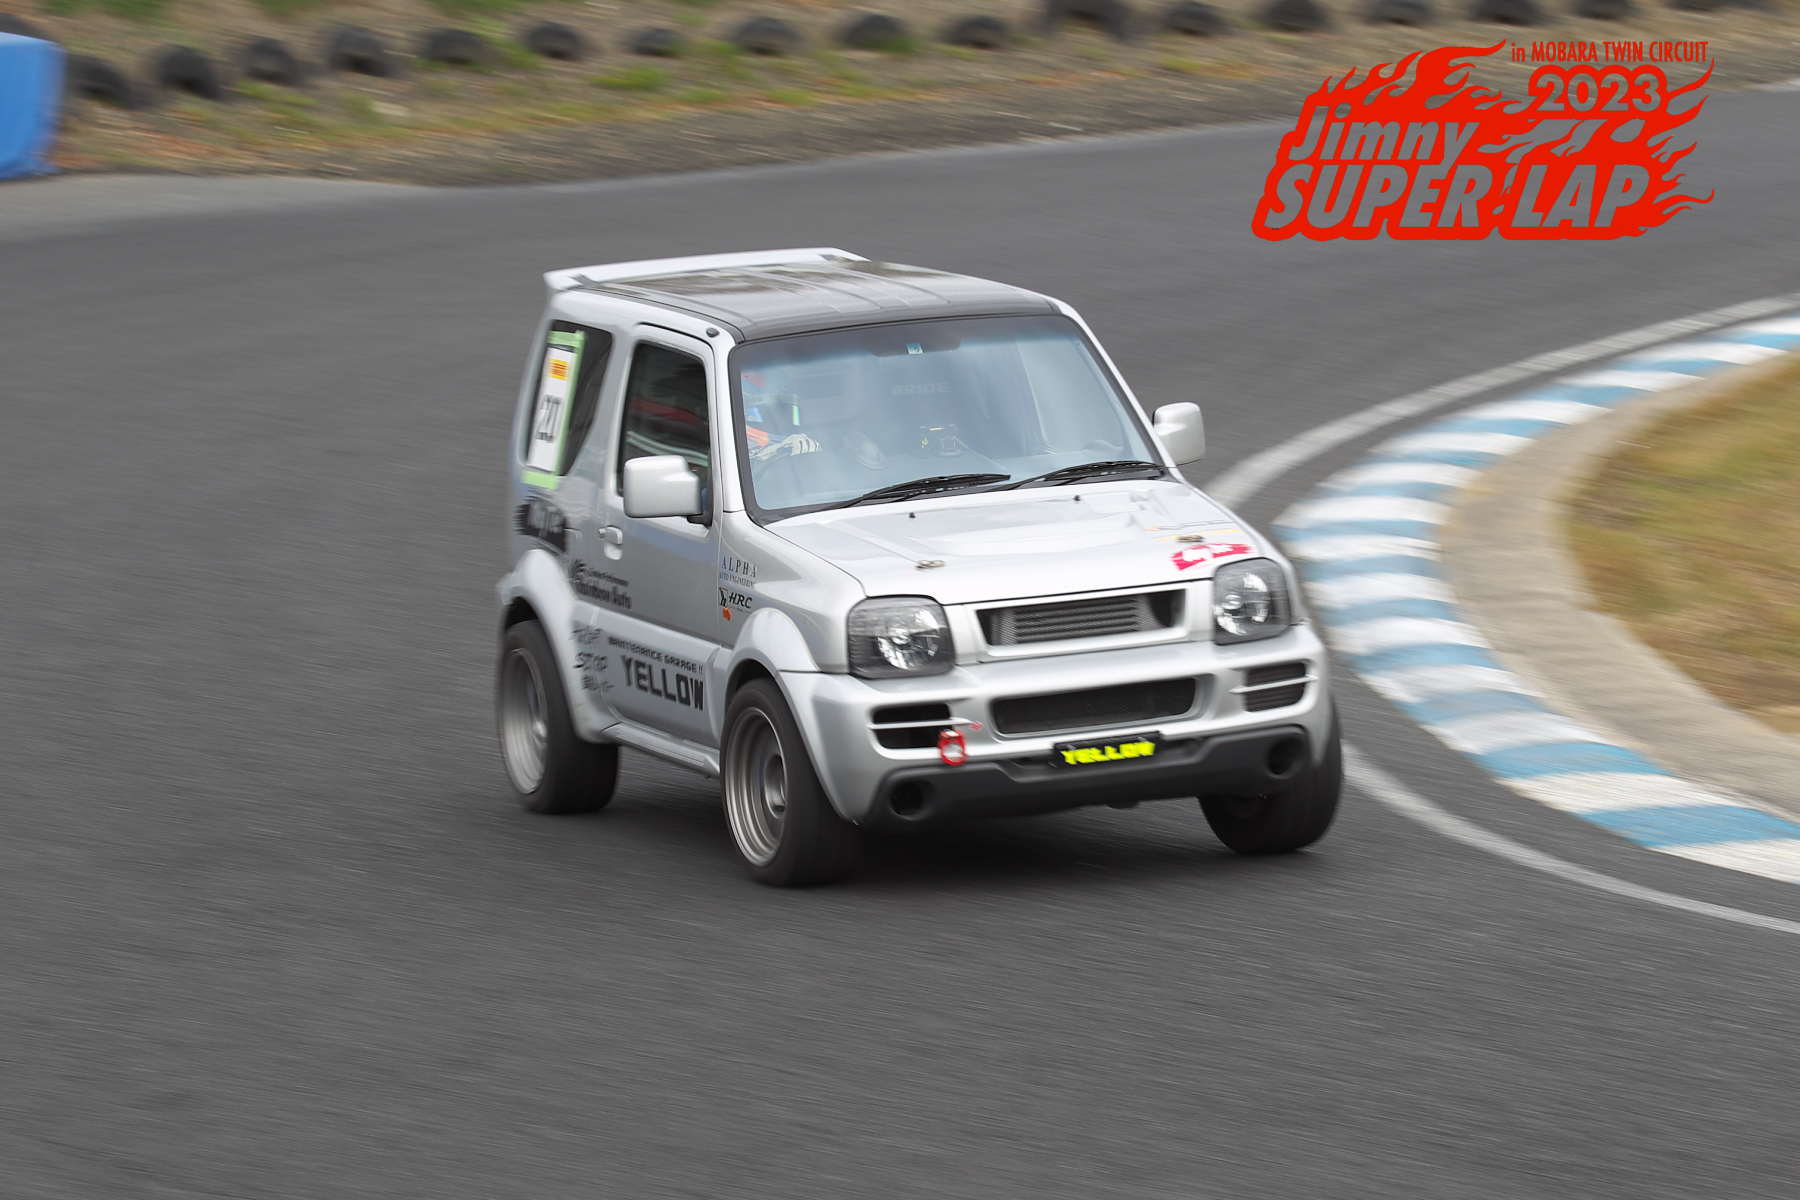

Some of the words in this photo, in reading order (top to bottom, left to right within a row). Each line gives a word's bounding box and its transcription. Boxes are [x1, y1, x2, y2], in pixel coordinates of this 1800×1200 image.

[891, 382, 950, 395] BRIDE
[721, 555, 757, 578] ALPHA
[728, 591, 753, 609] HRC
[620, 655, 704, 711] YELLOW
[1060, 741, 1155, 766] YELLOW
